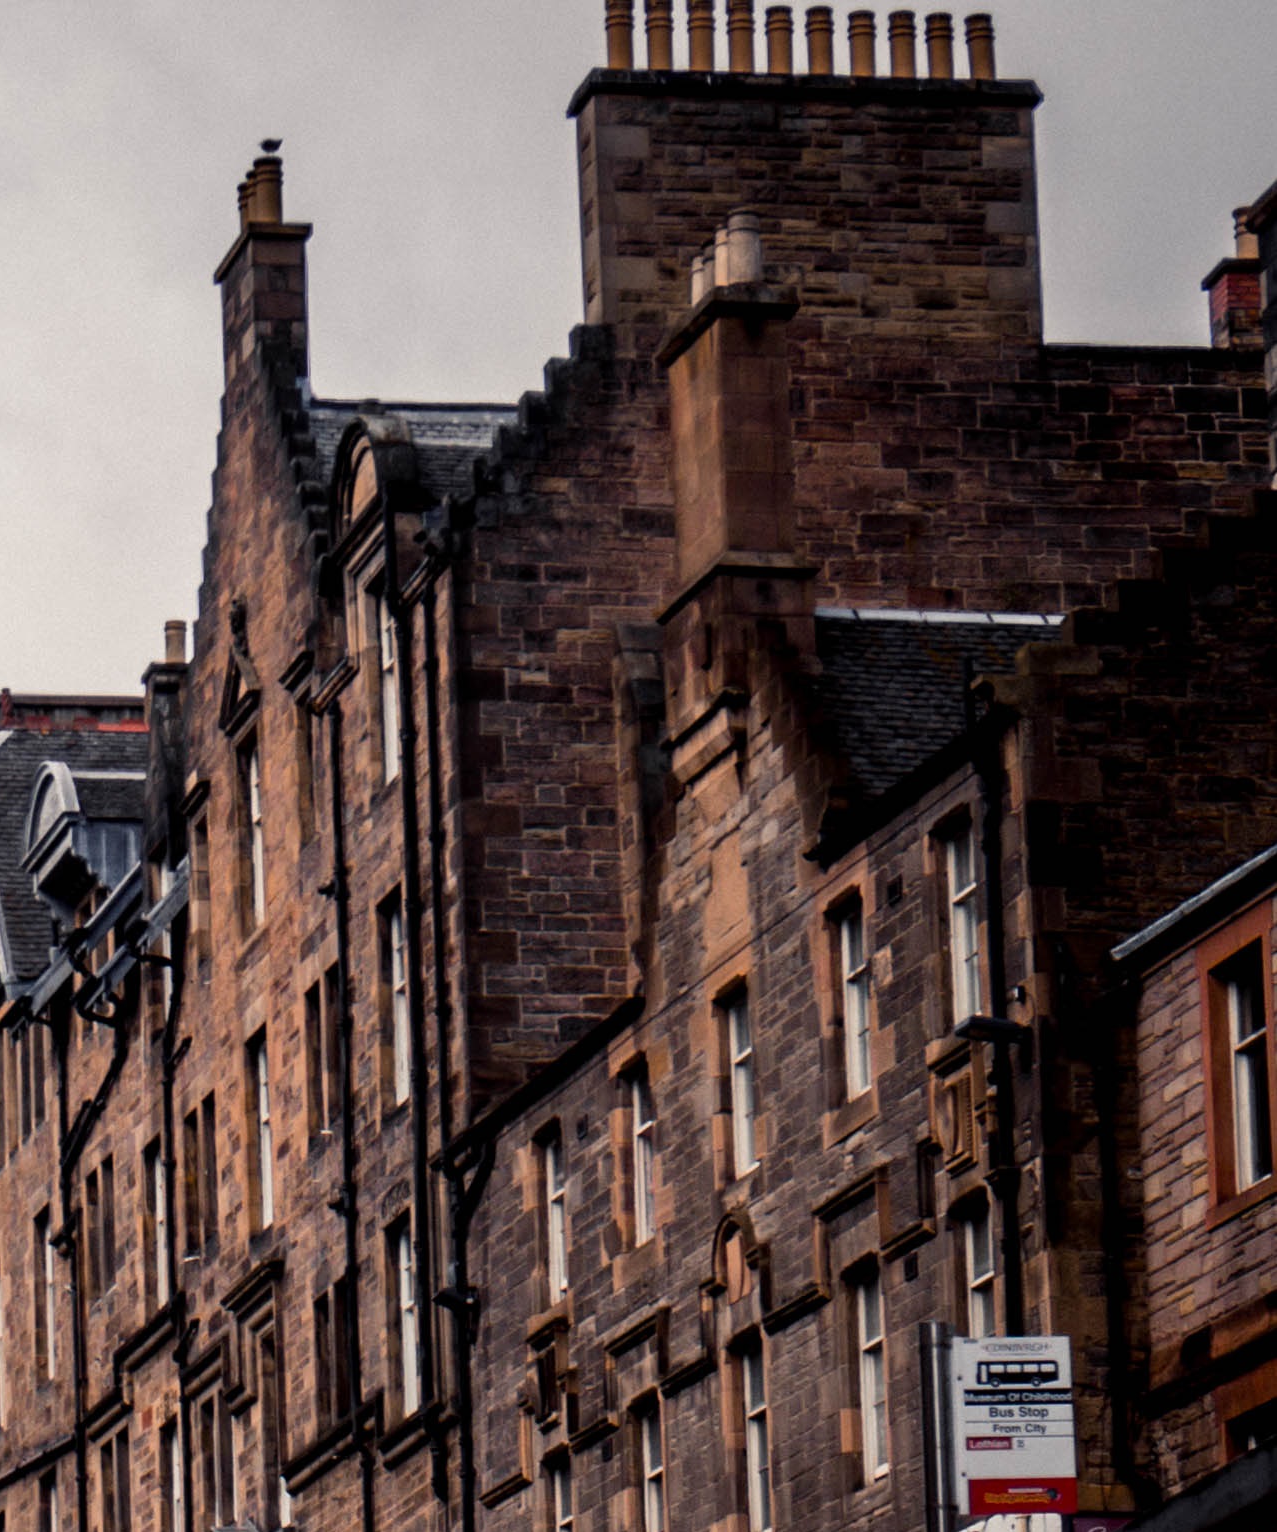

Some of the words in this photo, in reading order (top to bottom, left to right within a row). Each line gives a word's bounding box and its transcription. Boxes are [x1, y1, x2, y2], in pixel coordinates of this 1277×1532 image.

[964, 1392, 1007, 1402] Museum
[1021, 1391, 1072, 1402] Childhood
[989, 1407, 1015, 1418] Bus
[1019, 1406, 1049, 1421] Stop
[993, 1424, 1022, 1434] From
[1025, 1423, 1047, 1435] City
[968, 1439, 1010, 1449] Lothian
